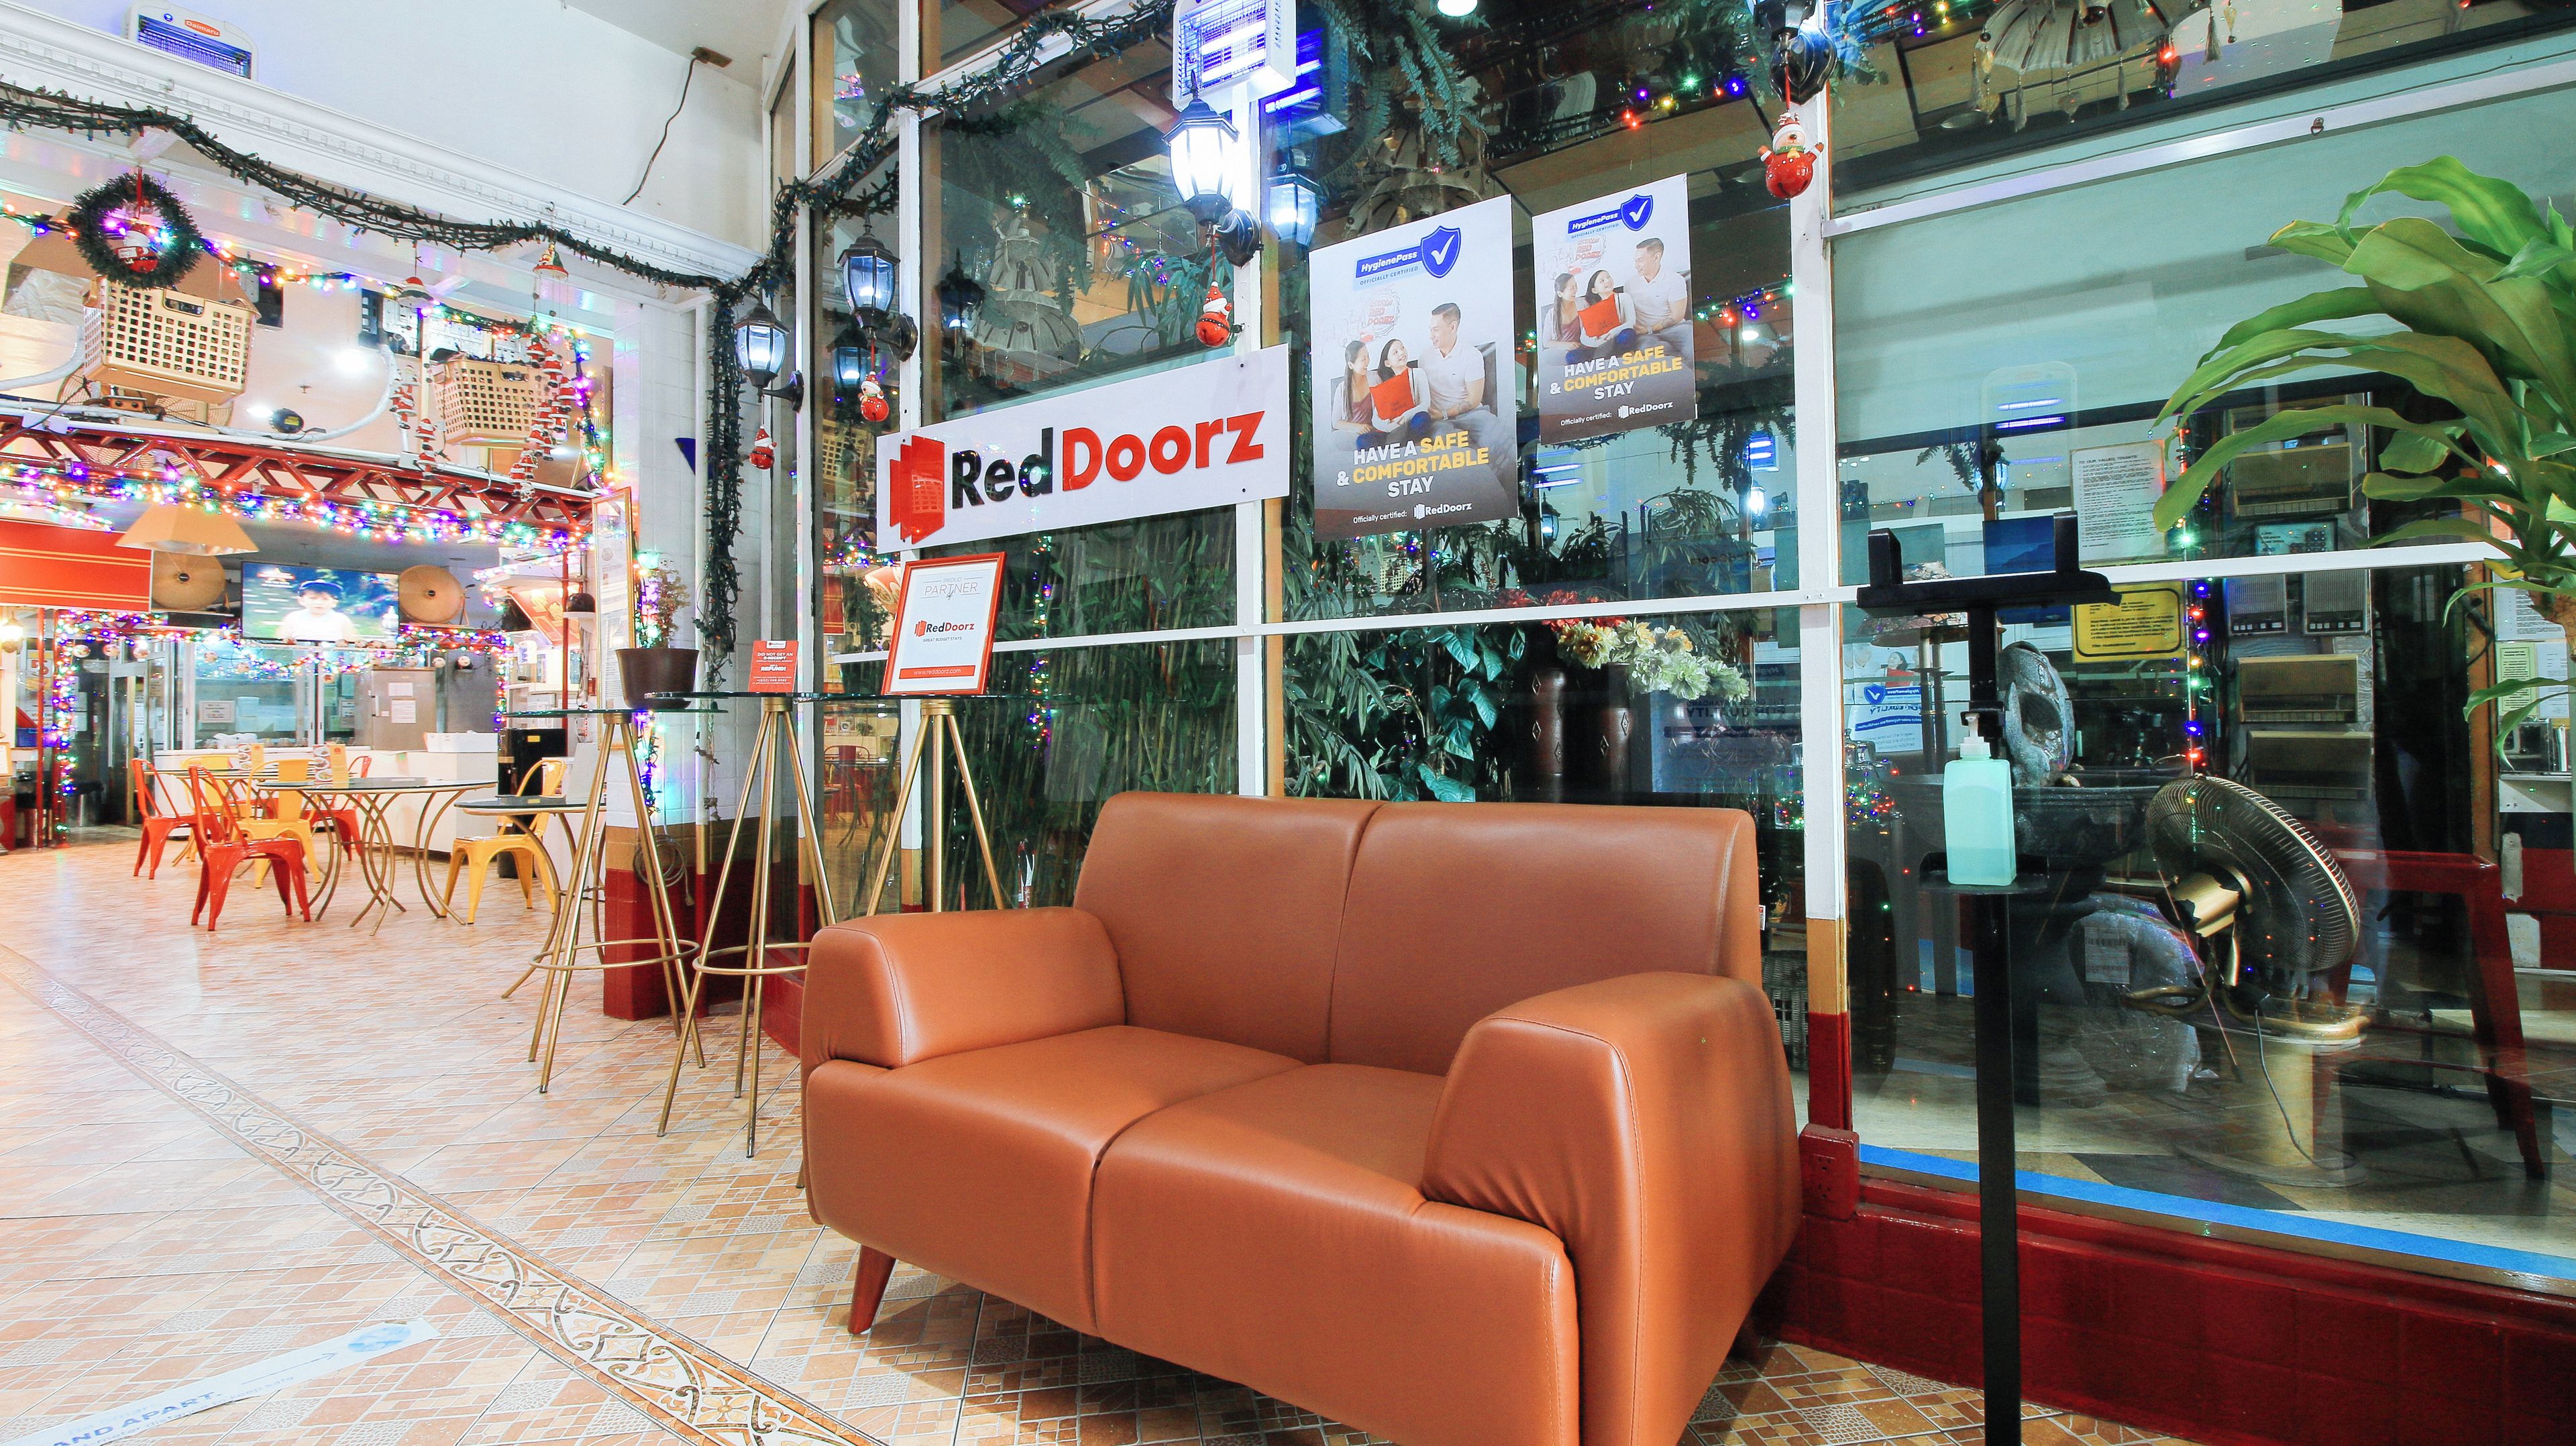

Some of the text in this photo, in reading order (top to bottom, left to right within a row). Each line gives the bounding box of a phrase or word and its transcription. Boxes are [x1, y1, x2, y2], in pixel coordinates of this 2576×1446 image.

[185, 20, 219, 36] Daimaru
[1572, 212, 1618, 230] HygienePass
[1571, 223, 1619, 239] OFFICIALLY CERTIFIED
[1577, 245, 1592, 253] RED
[1360, 251, 1417, 274] HygienePass
[1360, 266, 1418, 285] OFFICIALLY CERTIFIED
[1368, 307, 1385, 315] RED
[1564, 345, 1664, 378] HAVE A SAFE
[1550, 357, 1682, 395] & COMFORTABLE
[1594, 381, 1634, 400] STAY
[1629, 402, 1673, 415] RedDoorz
[1560, 412, 1612, 427] Officially certified:
[1354, 431, 1469, 465] HAVE A SAFE
[952, 410, 1265, 509] RedDoorz
[1336, 447, 1489, 486] & COMFORTABLE
[1387, 476, 1434, 498] STAY
[1353, 510, 1407, 524] Officially certified:
[1426, 503, 1472, 516] RedDoorz
[924, 581, 978, 596] PARTNER
[926, 622, 975, 632] RedDoorz
